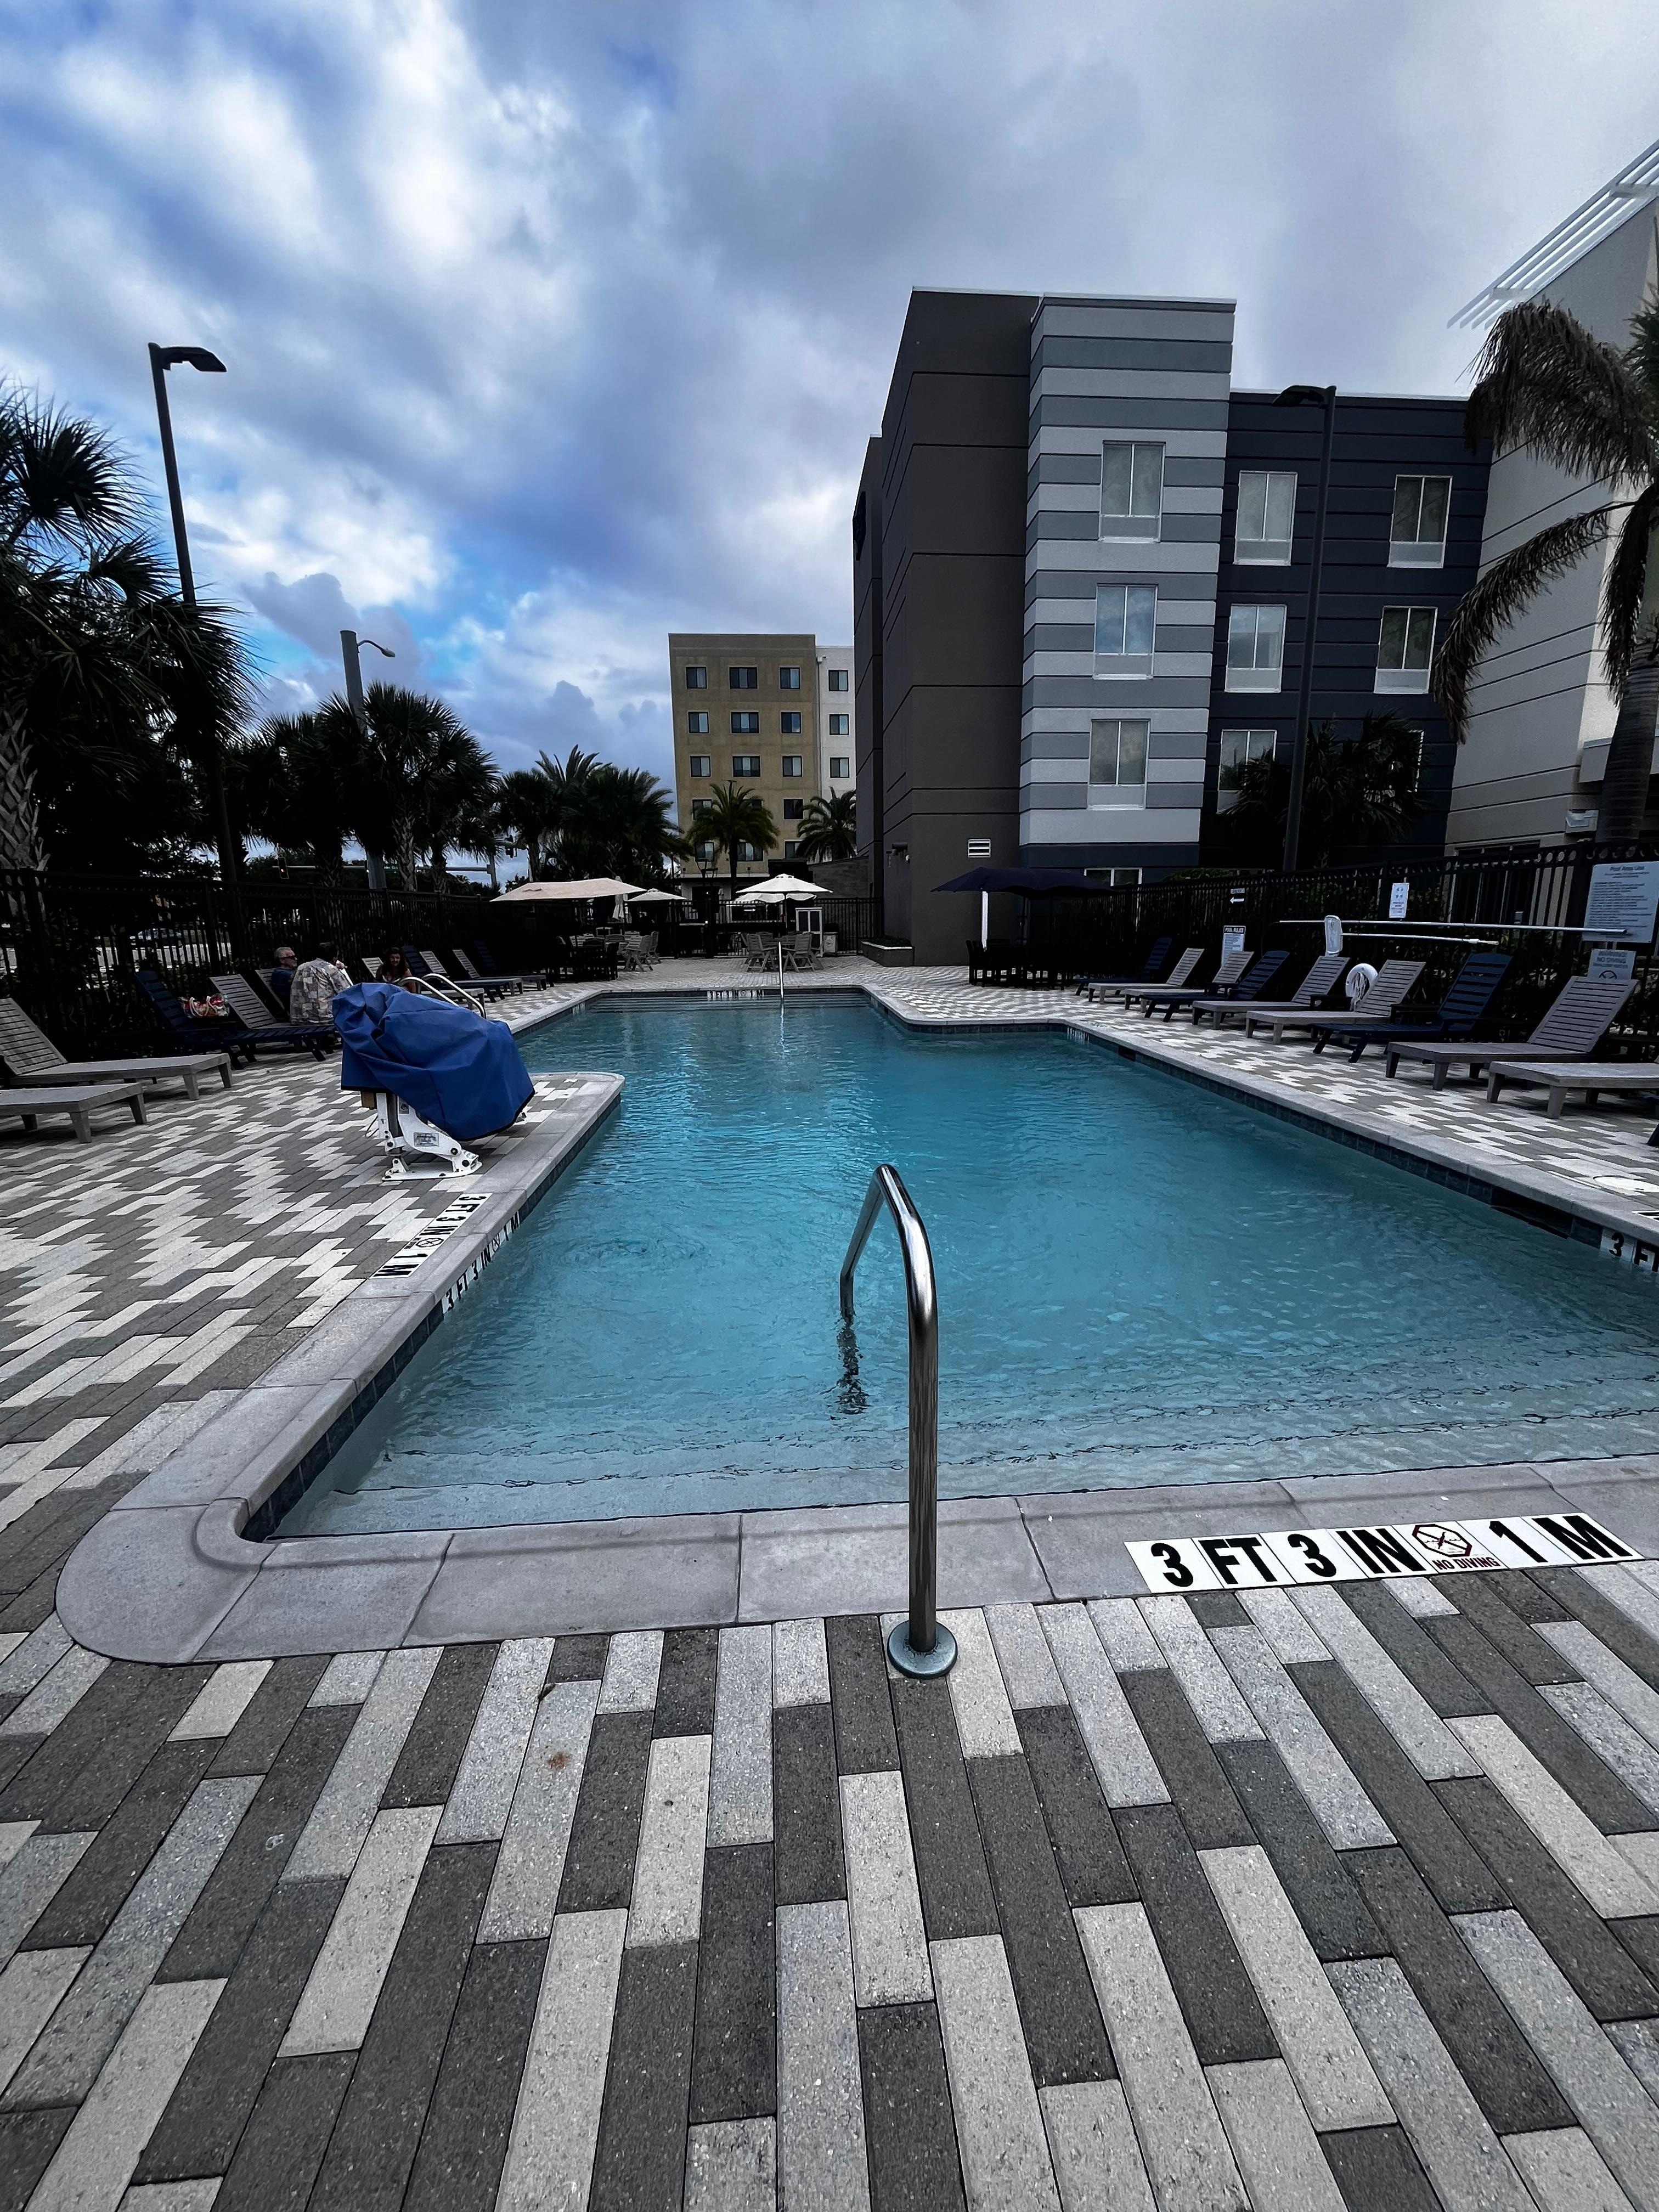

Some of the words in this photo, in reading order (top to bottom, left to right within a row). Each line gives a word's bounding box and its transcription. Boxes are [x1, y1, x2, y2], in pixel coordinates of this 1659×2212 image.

[445, 1203, 480, 1213] FT
[419, 1225, 459, 1236] IN
[1609, 1232, 1624, 1257] 3
[456, 1269, 468, 1300] FT
[480, 1244, 492, 1271] IN
[503, 1224, 509, 1242] 1
[510, 1211, 520, 1234] M
[372, 1263, 420, 1277] M
[1150, 1543, 1194, 1587] 3
[1198, 1537, 1278, 1584] FT
[1287, 1533, 1337, 1578] 3
[1335, 1528, 1426, 1575] IN
[1488, 1520, 1549, 1564] 1
[1531, 1515, 1634, 1560] M
[1431, 1559, 1455, 1570] NO
[1452, 1556, 1502, 1568] DIVING
